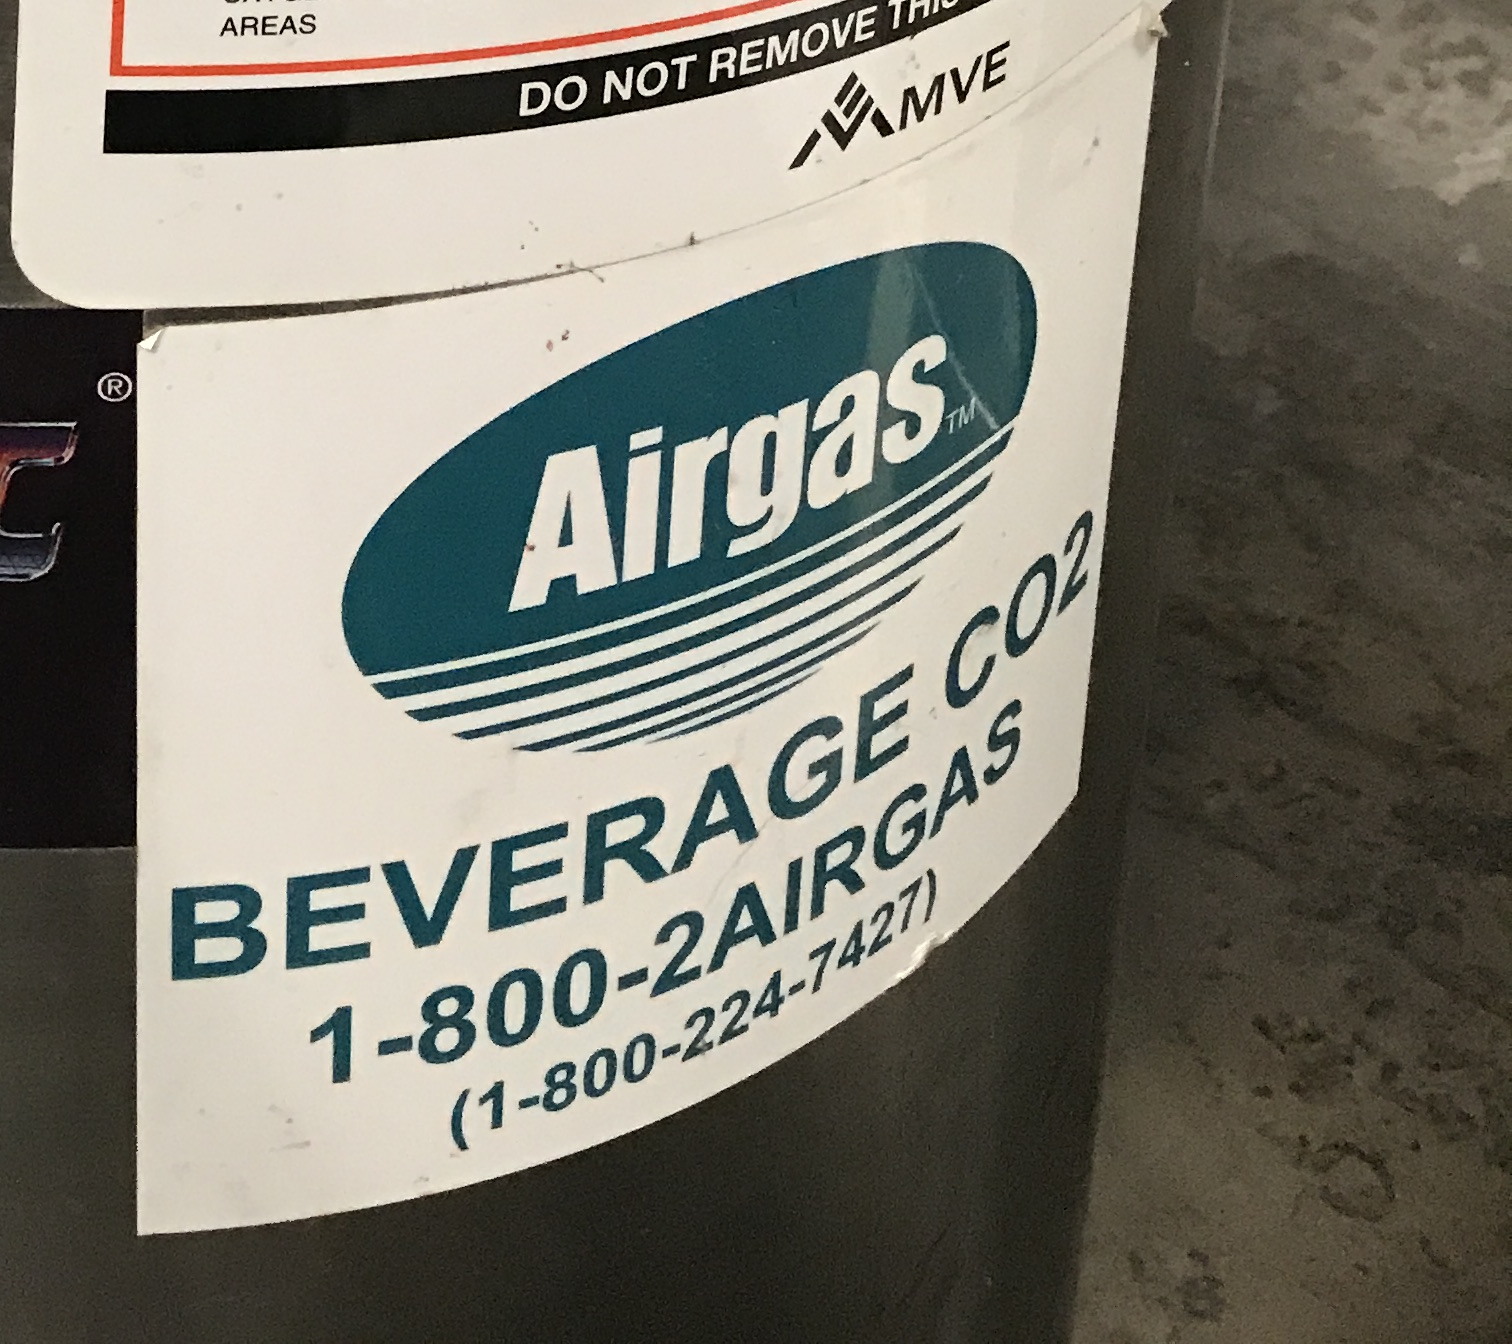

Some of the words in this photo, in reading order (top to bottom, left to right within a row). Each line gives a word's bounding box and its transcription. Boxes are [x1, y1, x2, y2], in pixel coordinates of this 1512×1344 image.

[219, 12, 318, 39] AREAS
[518, 75, 588, 118] DO
[601, 53, 698, 106] NOT
[707, 4, 879, 85] REMOVE
[897, 39, 1012, 132] MVE
[506, 331, 950, 615] Airgas
[169, 662, 915, 983] BEVERAGE
[944, 510, 1094, 712] CO2
[308, 697, 1024, 1086] 1-800-2AIRGAS
[449, 867, 939, 1153] (1-800-224-7427)
